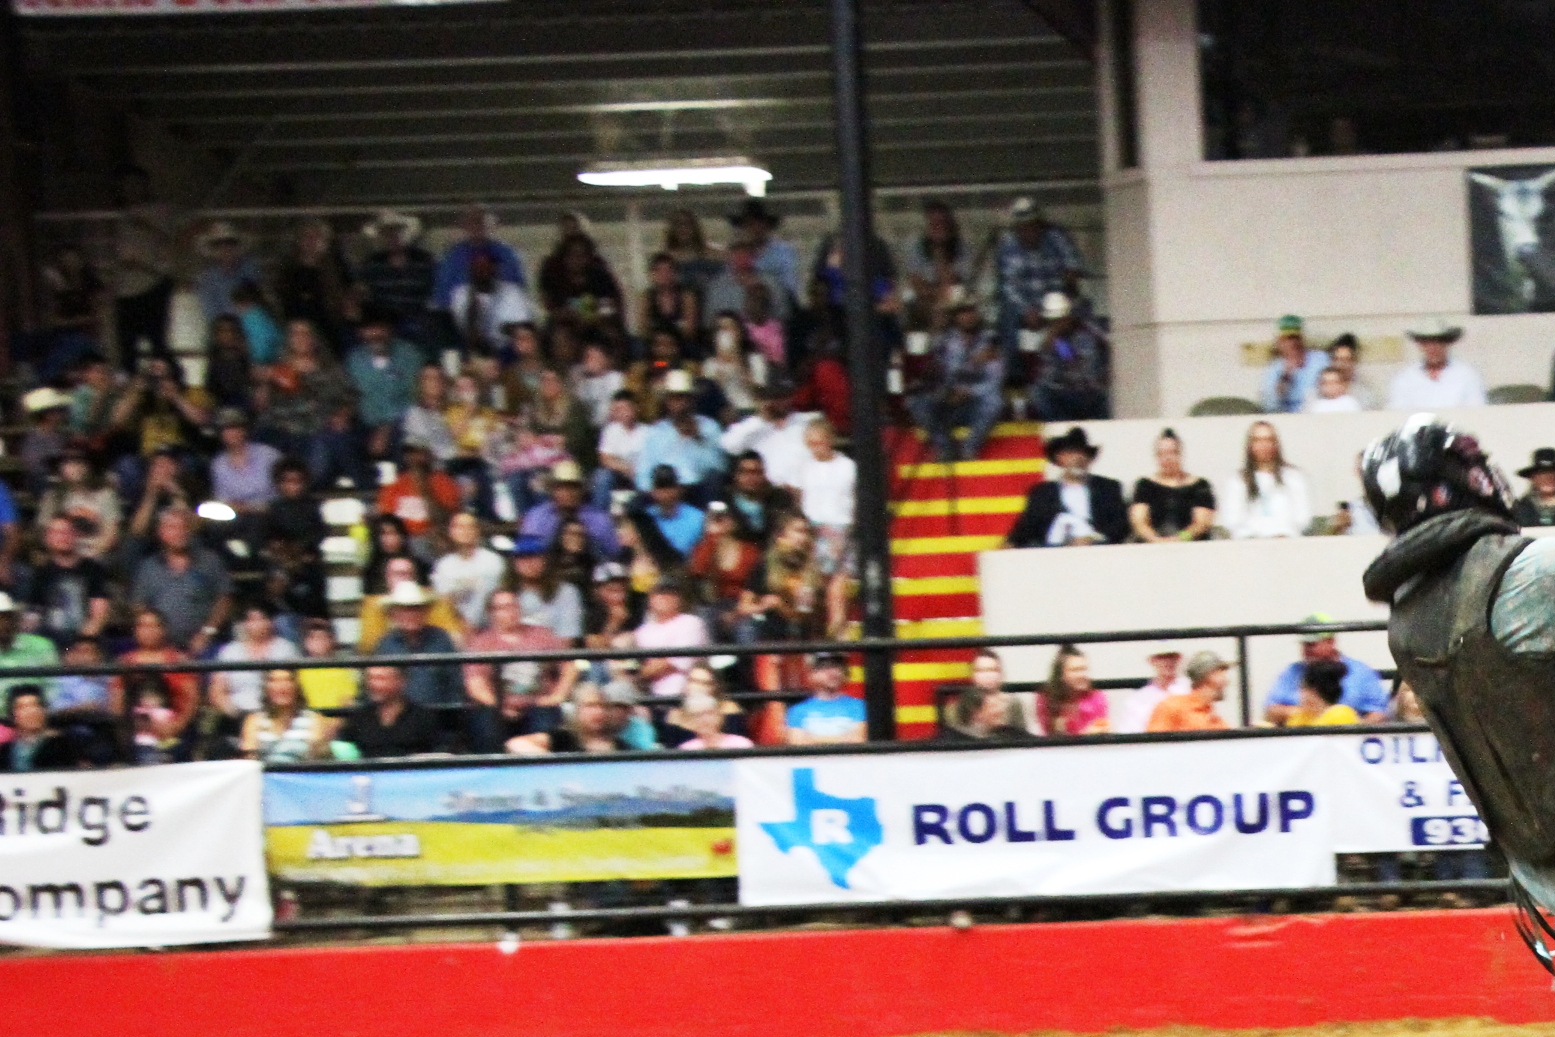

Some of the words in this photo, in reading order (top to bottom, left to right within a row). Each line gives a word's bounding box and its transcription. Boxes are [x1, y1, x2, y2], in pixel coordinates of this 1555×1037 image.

[1400, 780, 1425, 808] &
[809, 808, 851, 845] R
[912, 800, 1076, 845] ROLL
[1096, 790, 1316, 840] GROUP
